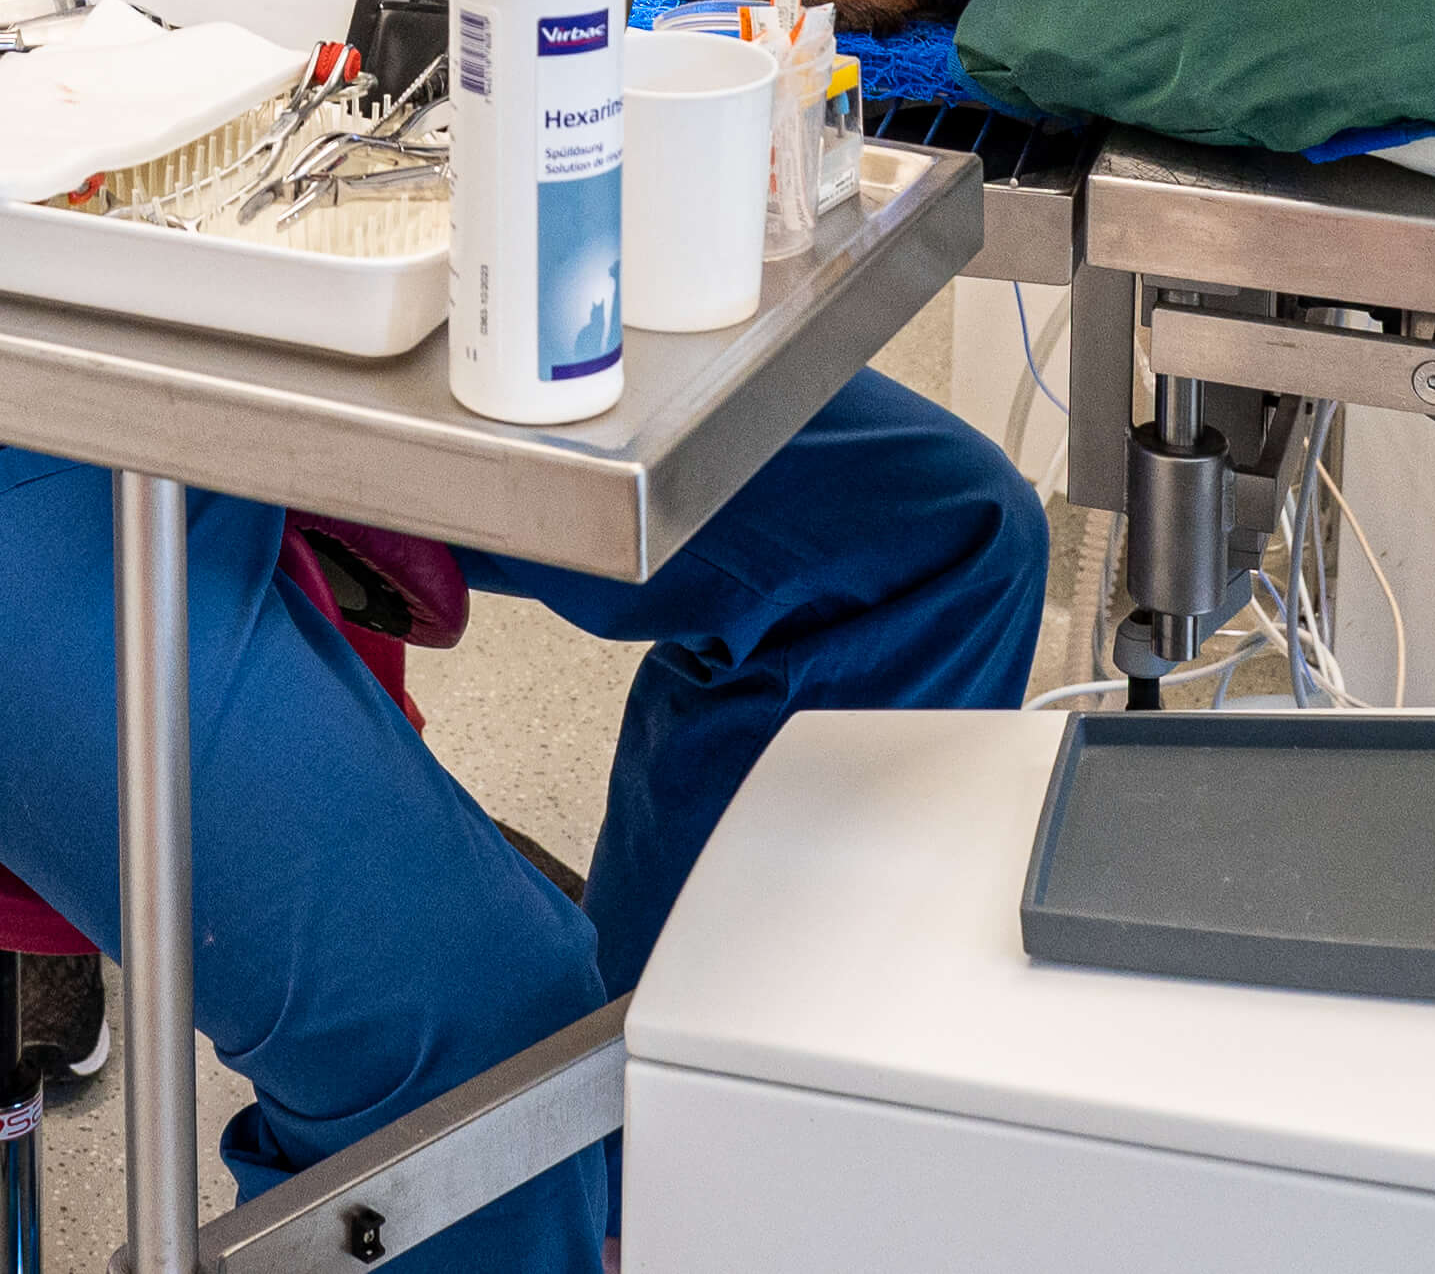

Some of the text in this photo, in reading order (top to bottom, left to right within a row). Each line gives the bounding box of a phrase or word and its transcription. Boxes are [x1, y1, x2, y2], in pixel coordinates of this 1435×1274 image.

[541, 23, 606, 44] Virbac
[544, 141, 604, 160] Spüllösung
[544, 160, 592, 175] Solution
